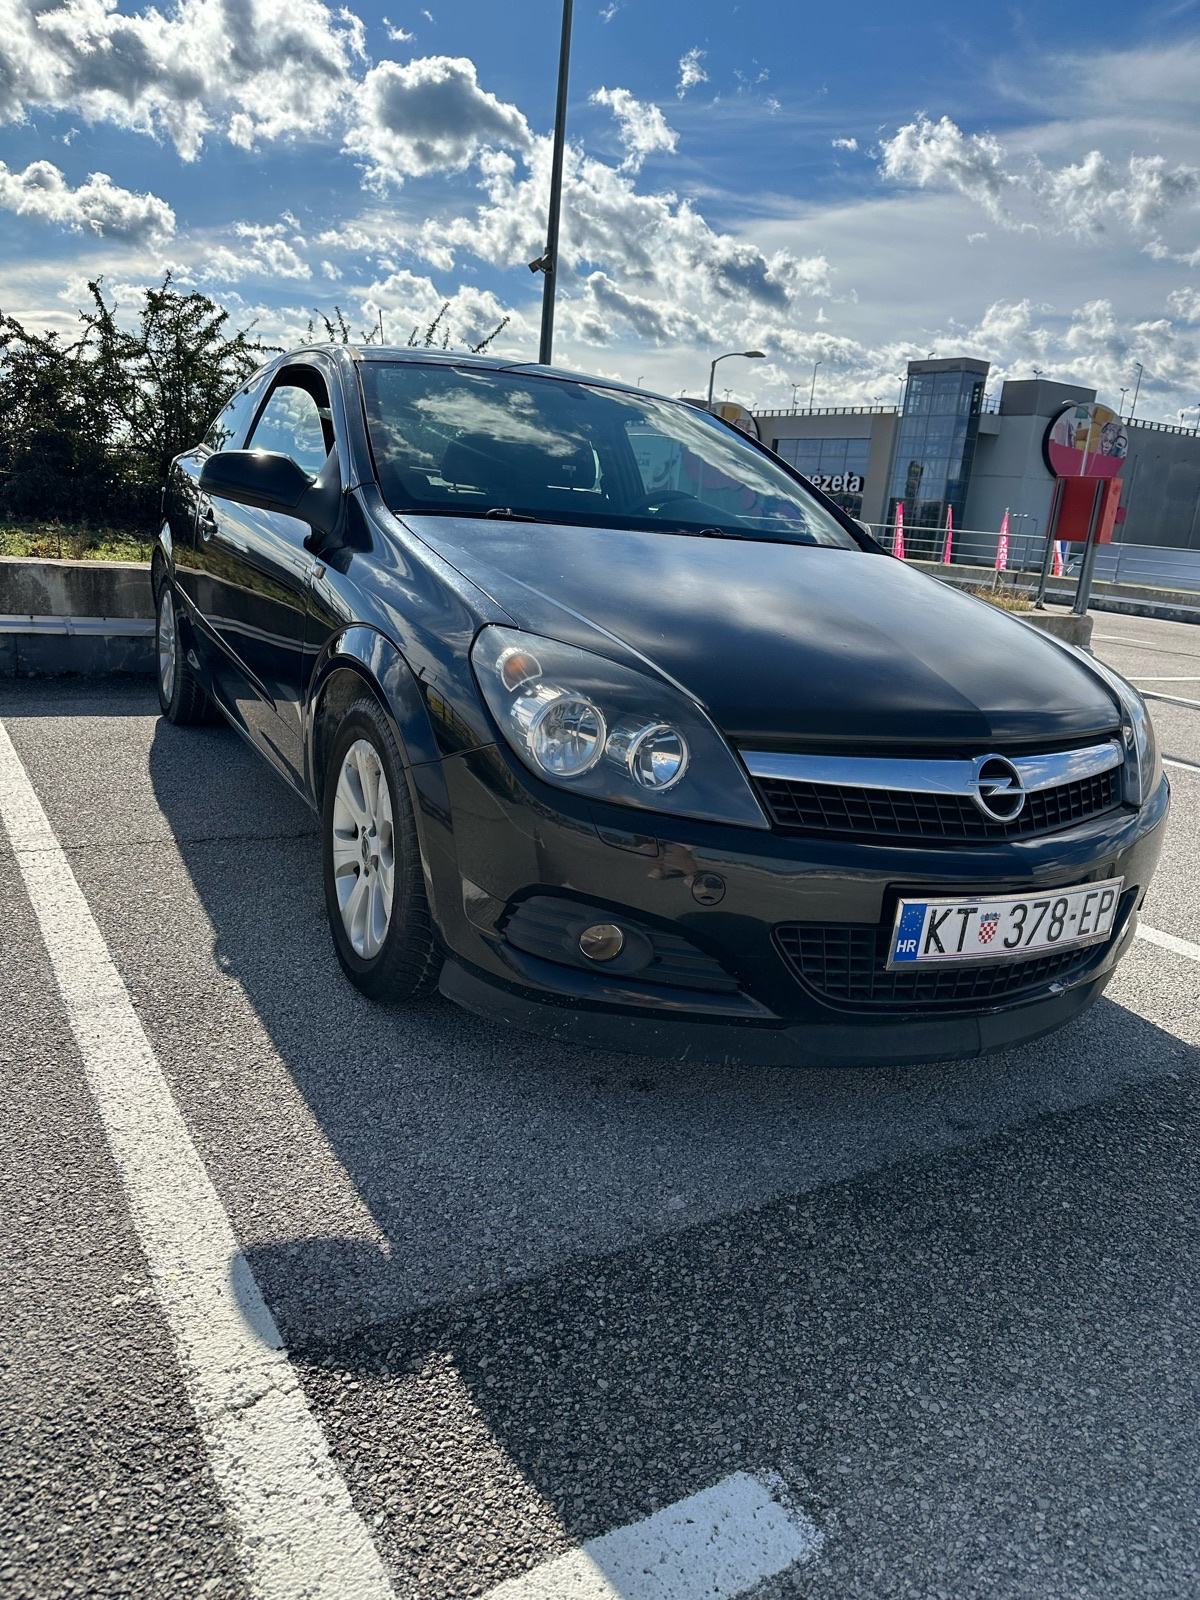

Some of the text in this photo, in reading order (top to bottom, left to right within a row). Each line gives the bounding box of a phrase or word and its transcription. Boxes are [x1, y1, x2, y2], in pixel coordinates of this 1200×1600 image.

[923, 890, 1115, 954] KT 378-EP
[896, 939, 917, 953] HR
